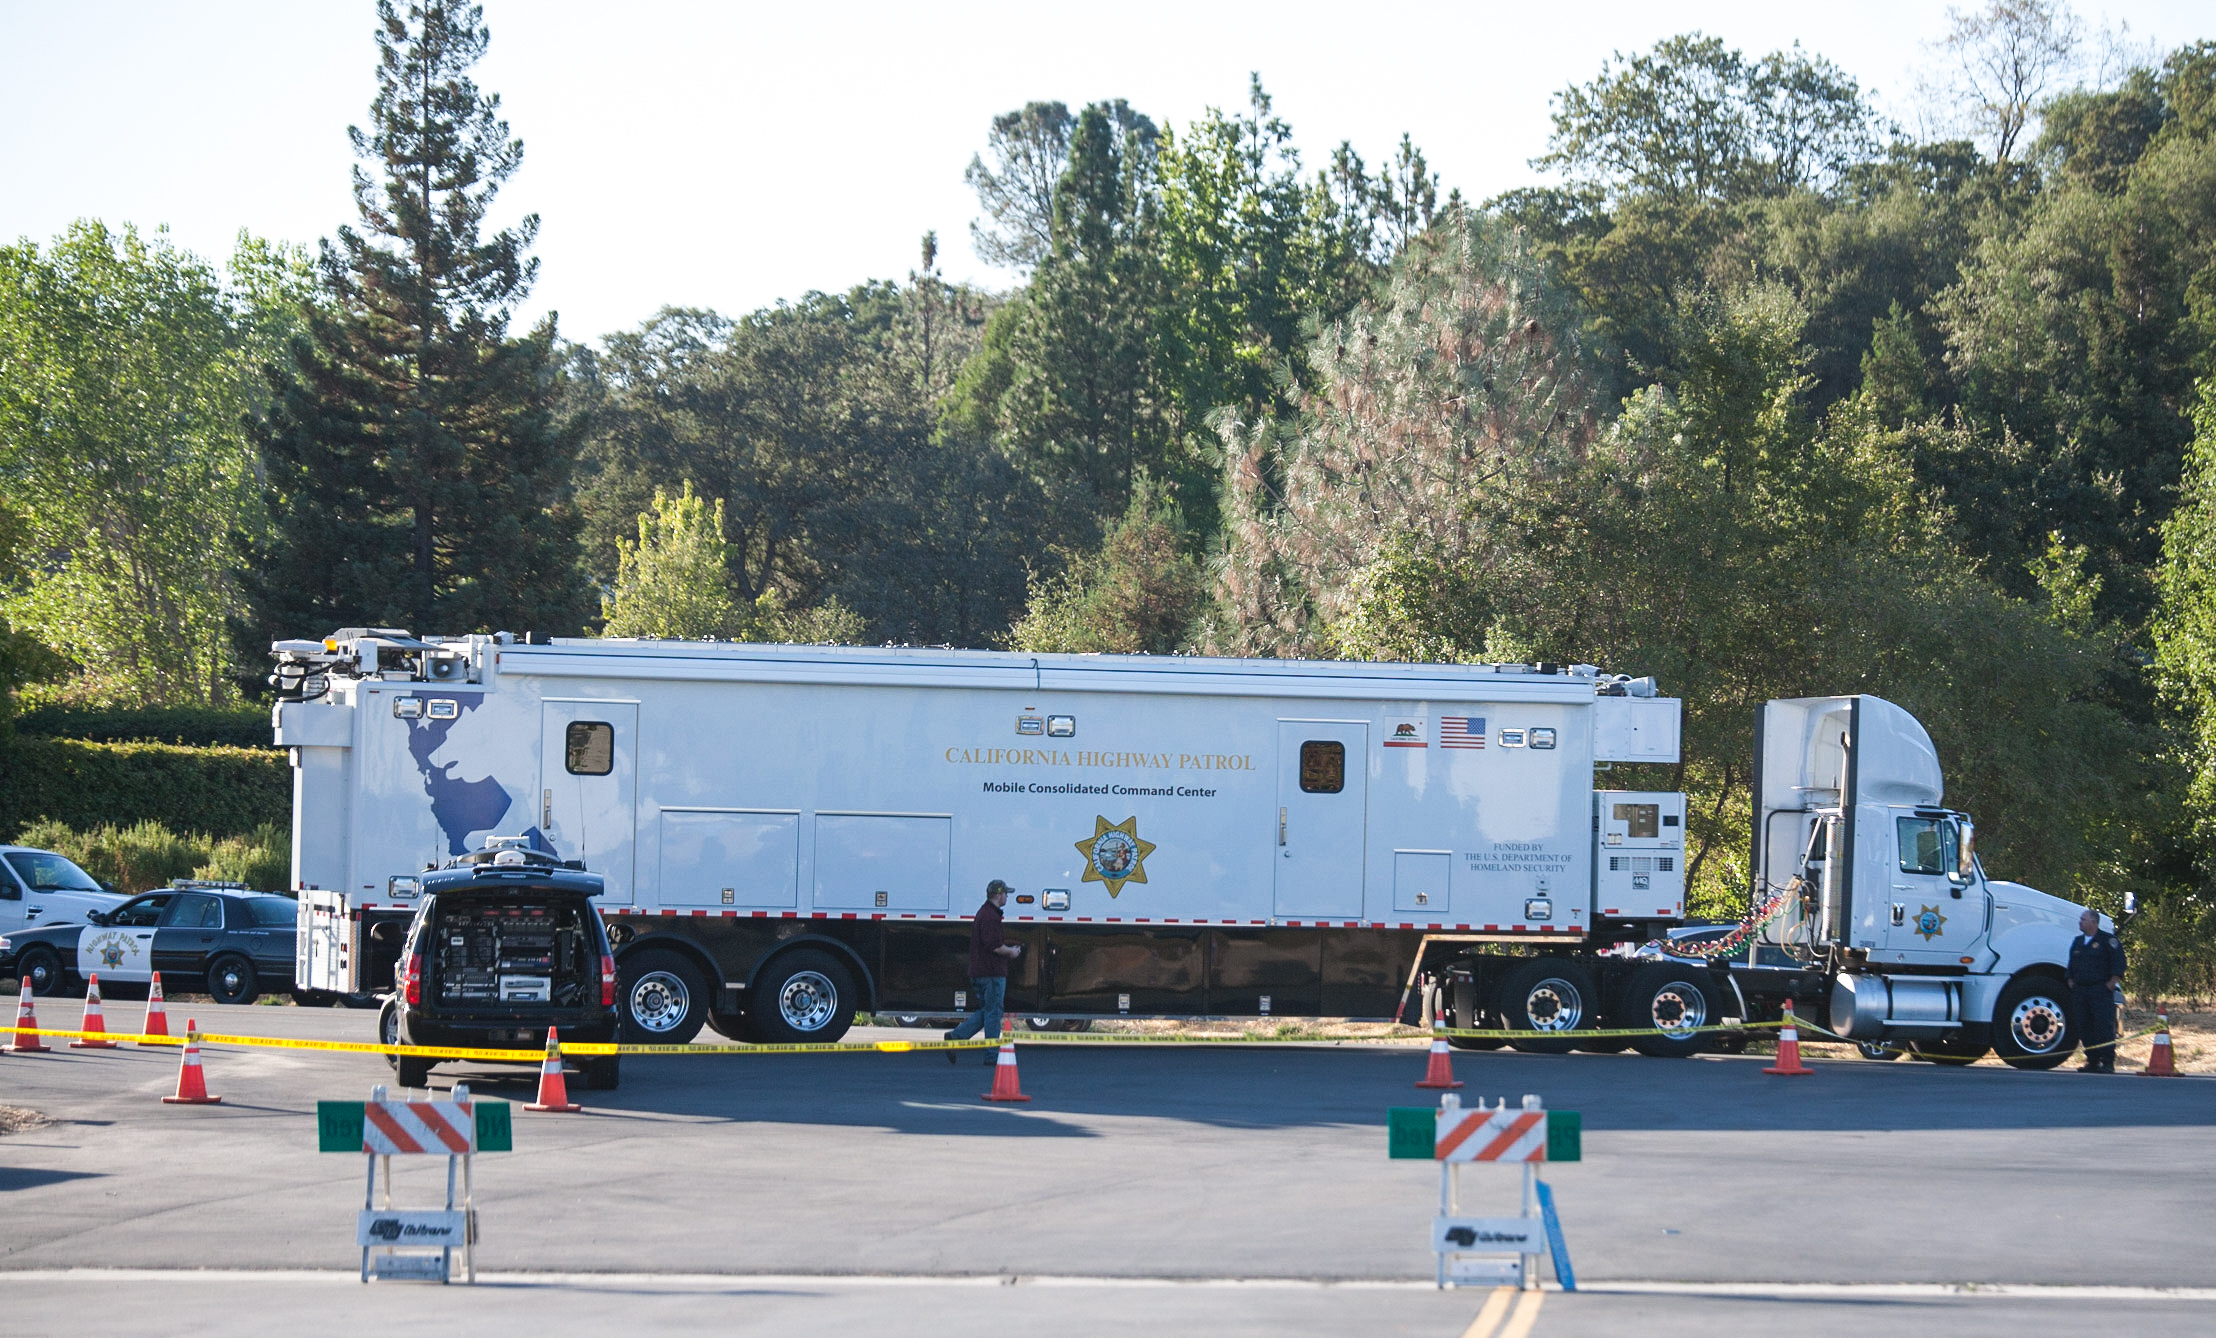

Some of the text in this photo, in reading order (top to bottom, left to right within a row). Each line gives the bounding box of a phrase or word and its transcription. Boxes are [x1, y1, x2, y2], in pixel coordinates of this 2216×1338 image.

[945, 747, 1256, 771] CALIFORNIA HIGHWAY PATROL
[982, 781, 1217, 798] Mobile Consolidated Command Center
[1493, 843, 1544, 852] FUNDED BY
[1464, 852, 1574, 863] THE U.S. DEPARTMENT OF
[1470, 863, 1567, 873] HOMELAND SECURITY
[85, 931, 140, 956] HIGHWAY PATROL
